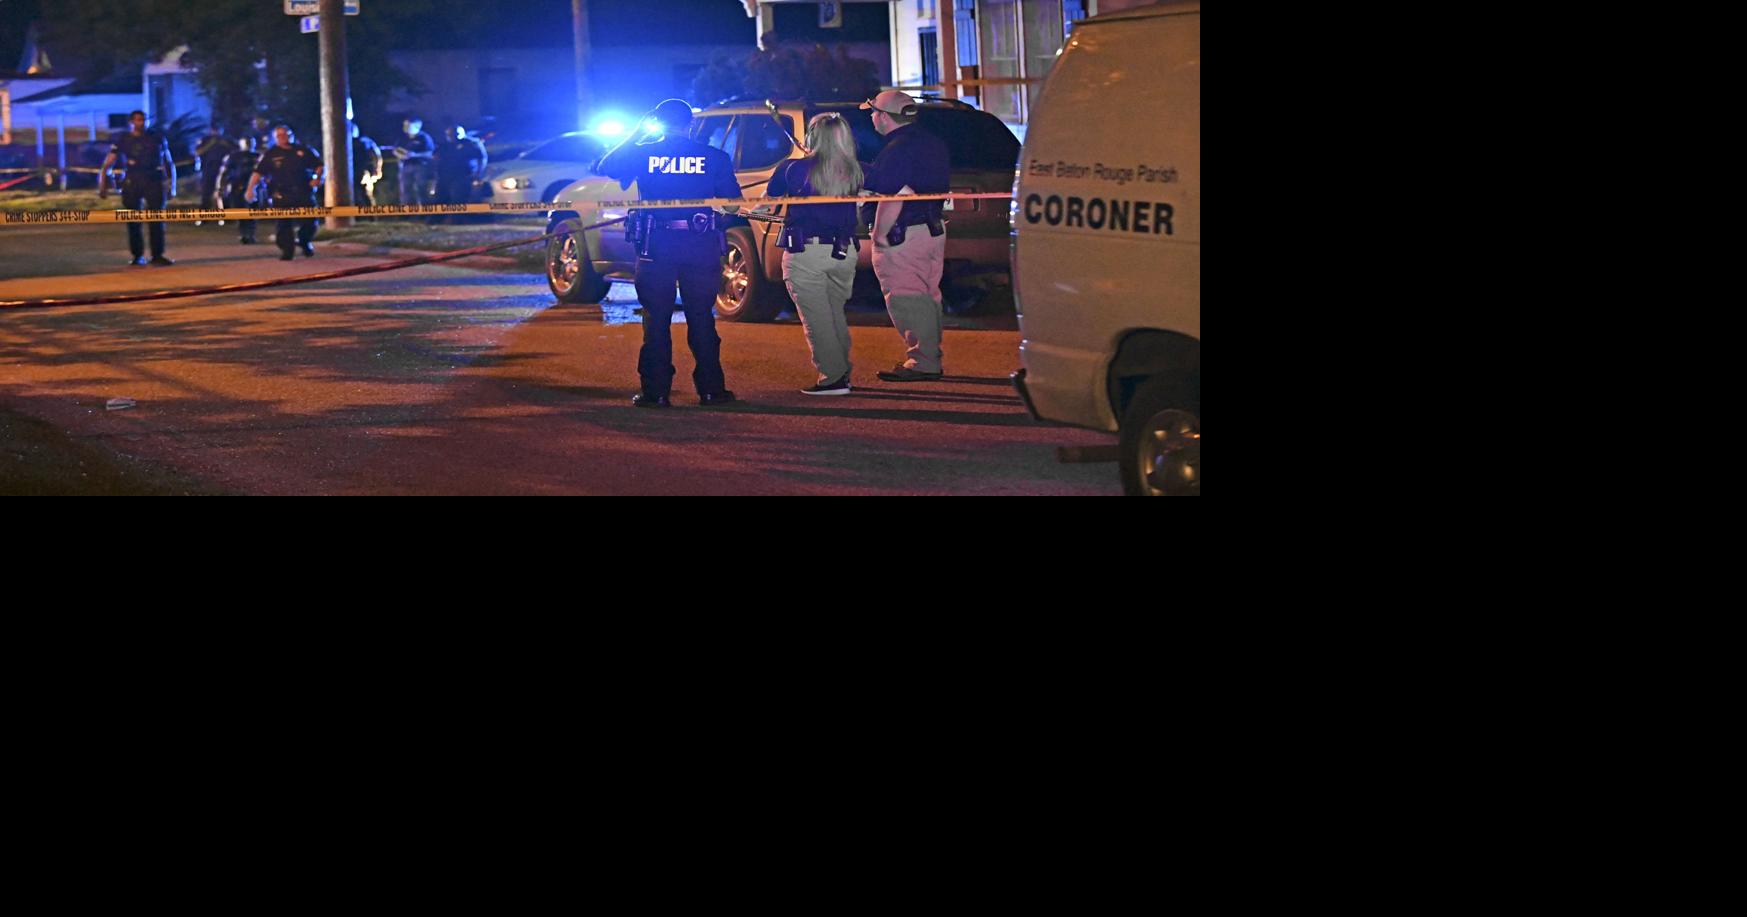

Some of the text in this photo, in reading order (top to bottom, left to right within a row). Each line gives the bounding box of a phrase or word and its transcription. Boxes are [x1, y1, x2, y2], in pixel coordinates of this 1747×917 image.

[648, 155, 706, 174] POLICE
[1029, 159, 1179, 186] East Baton Rouge Parish
[5, 210, 25, 222] CRIME
[115, 210, 143, 221] POLICE
[145, 209, 164, 220] LINE
[1024, 193, 1175, 236] CORONER
